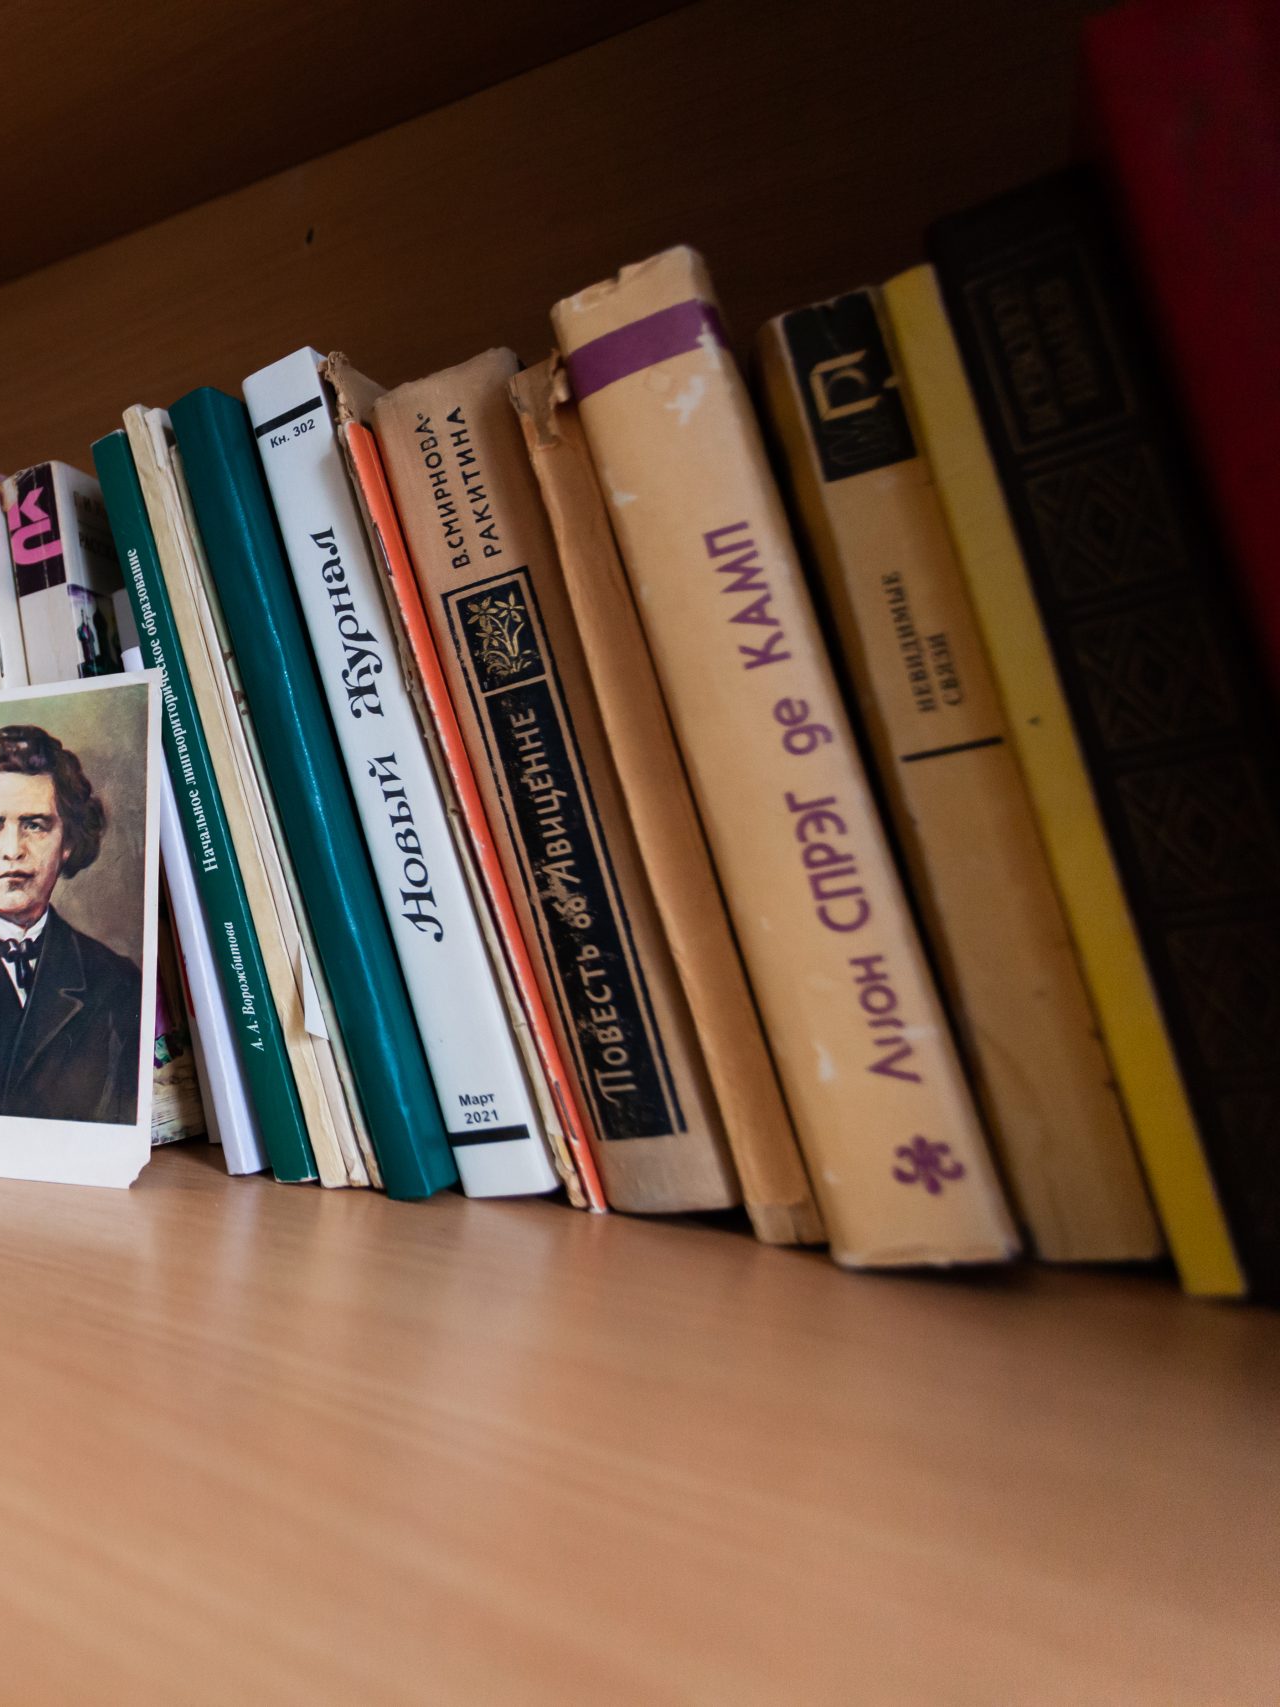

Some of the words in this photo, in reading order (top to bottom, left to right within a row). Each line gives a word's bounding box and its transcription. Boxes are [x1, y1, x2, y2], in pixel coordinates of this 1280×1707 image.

[269, 430, 290, 449] Кн.
[293, 417, 317, 439] 302
[447, 406, 502, 559] РАКИТИНА
[126, 548, 158, 637] образование
[309, 525, 385, 719] Журнал
[701, 520, 793, 671] КАМП
[880, 570, 938, 713] НЕВИДИМЫЕ
[926, 631, 964, 707] СВЯЗИ
[188, 789, 219, 873] Начальное
[366, 751, 444, 943] Новый
[783, 791, 872, 933] СПРЭГ
[223, 920, 256, 1017] Ворожбитова
[246, 1019, 261, 1035] А.
[249, 1033, 265, 1052] А.
[458, 1093, 495, 1107] Март
[464, 1109, 500, 1125] 2021
